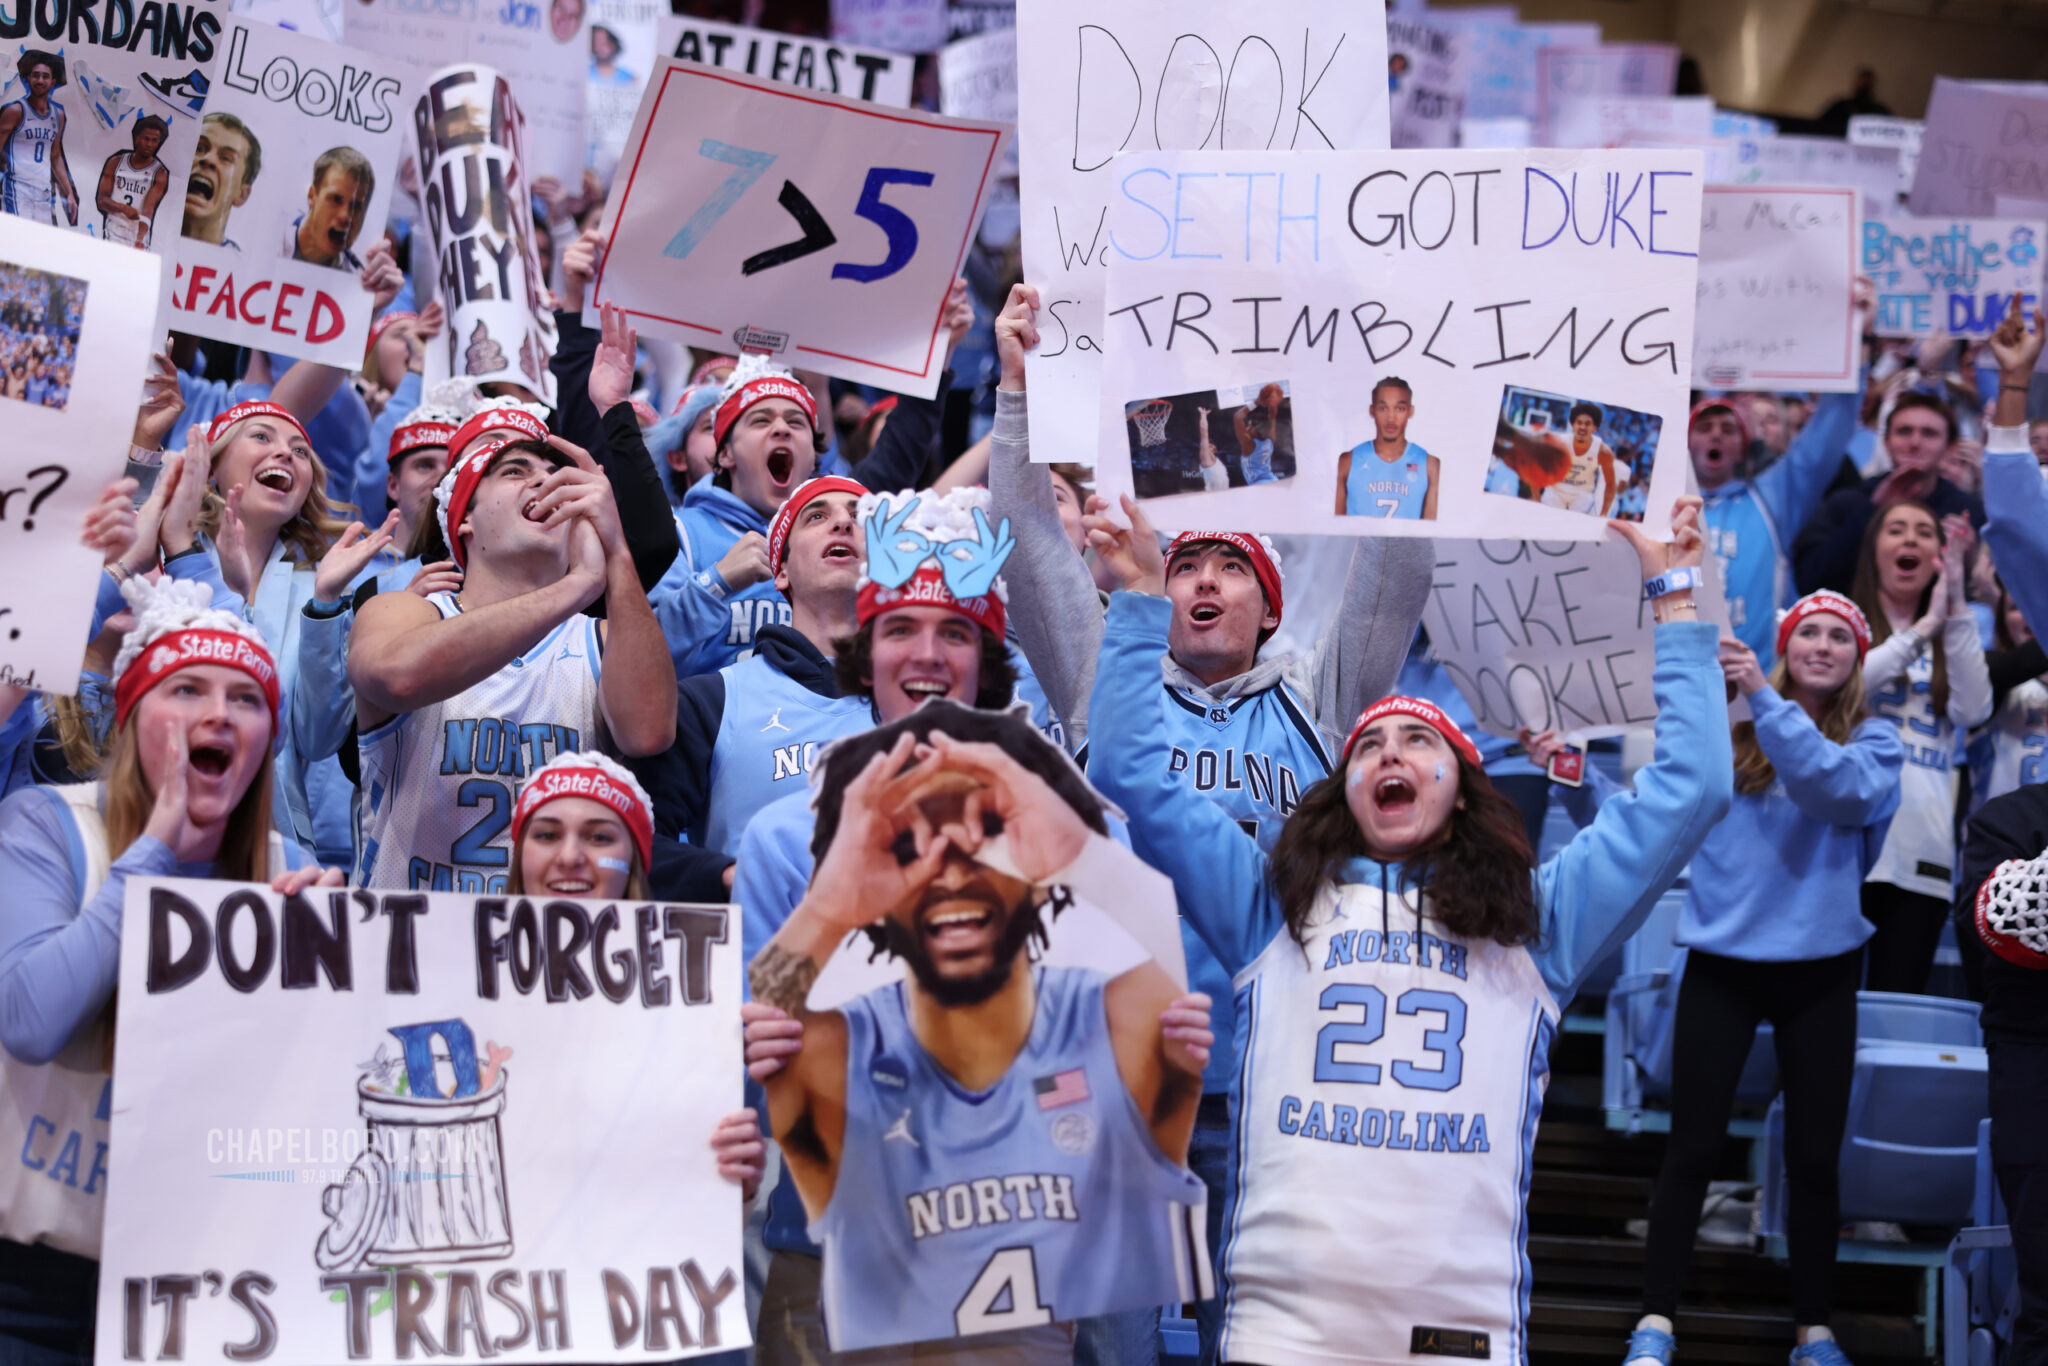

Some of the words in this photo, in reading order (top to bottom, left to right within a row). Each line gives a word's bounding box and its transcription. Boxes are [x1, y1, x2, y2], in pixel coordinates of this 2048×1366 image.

[224, 26, 400, 133] LOOKS
[1073, 25, 1345, 171] DOOK
[34, 141, 45, 163] 0
[116, 175, 146, 195] Duke
[1109, 168, 1322, 263] SETH
[1348, 169, 1502, 250] GOT
[1522, 167, 1698, 258] DUKE
[1924, 271, 1979, 289] YOU
[1108, 291, 1678, 375] TRIMBLING
[1948, 293, 2037, 335] DUKE
[1368, 480, 1409, 496] NORTH
[1375, 498, 1402, 520] 7
[1433, 566, 1613, 652] TAKE
[148, 886, 429, 994] DON'T
[474, 898, 729, 1009] FORGET
[1324, 929, 1468, 981] NORTH
[1313, 982, 1468, 1093] 23
[1278, 1095, 1490, 1154] CAROLINA
[907, 1173, 1079, 1239] NORTH
[122, 1269, 278, 1362] IT'S
[319, 1265, 574, 1360] TRASH
[600, 1257, 741, 1351] DAY
[954, 1244, 1055, 1337] 4
[1474, 1338, 1486, 1352] M
